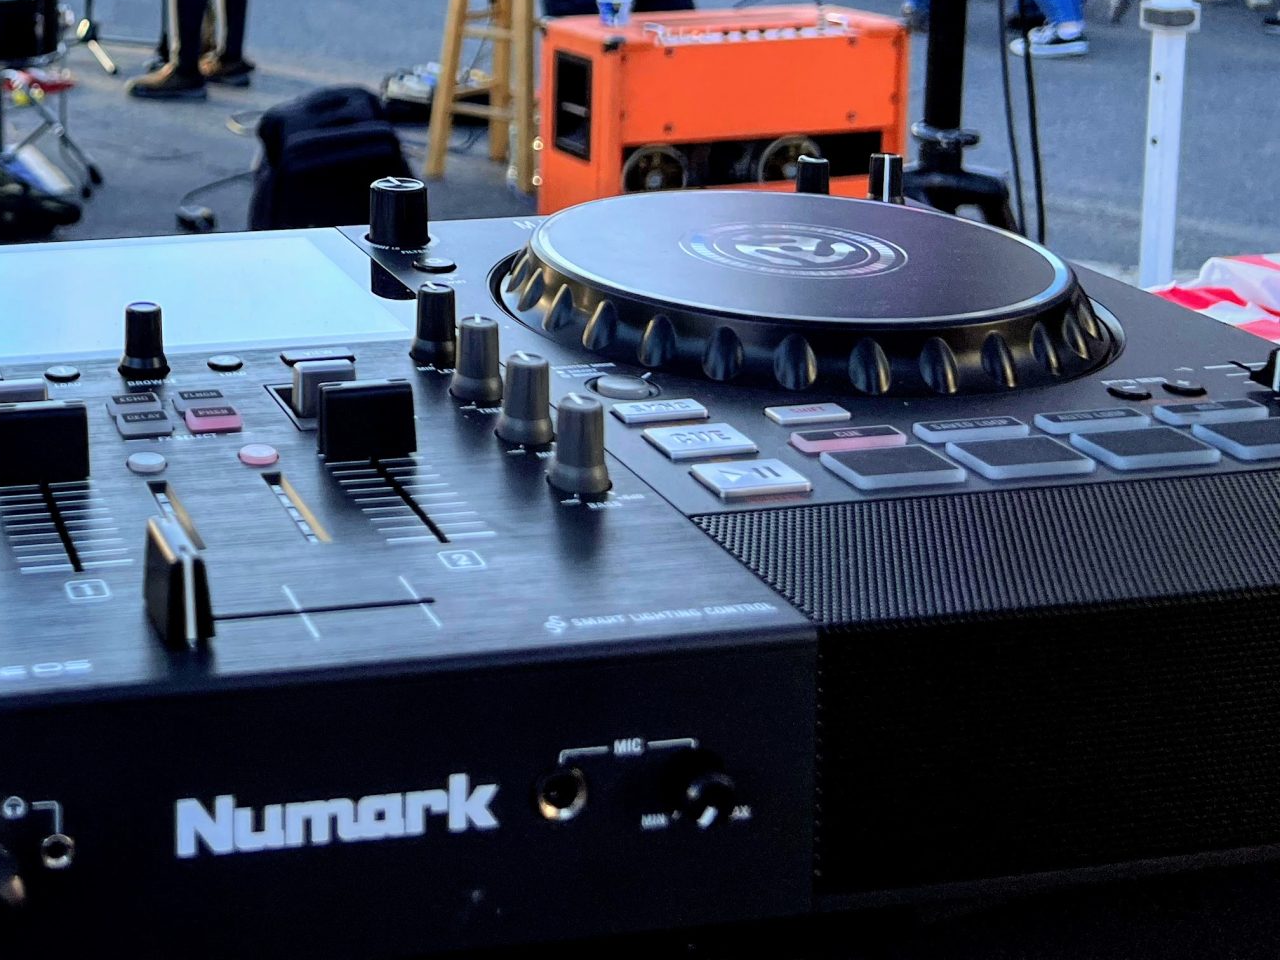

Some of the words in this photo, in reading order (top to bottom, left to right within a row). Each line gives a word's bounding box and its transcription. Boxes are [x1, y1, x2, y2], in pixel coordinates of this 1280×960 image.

[118, 395, 150, 403] ECHO
[669, 429, 732, 444] CUE
[570, 614, 625, 627] SMART
[628, 607, 703, 623] LIGHTING
[703, 601, 778, 616] CONTROL
[613, 737, 644, 756] MIC
[176, 772, 499, 859] Numark
[641, 812, 669, 830] MIN
[729, 804, 753, 821] AX
